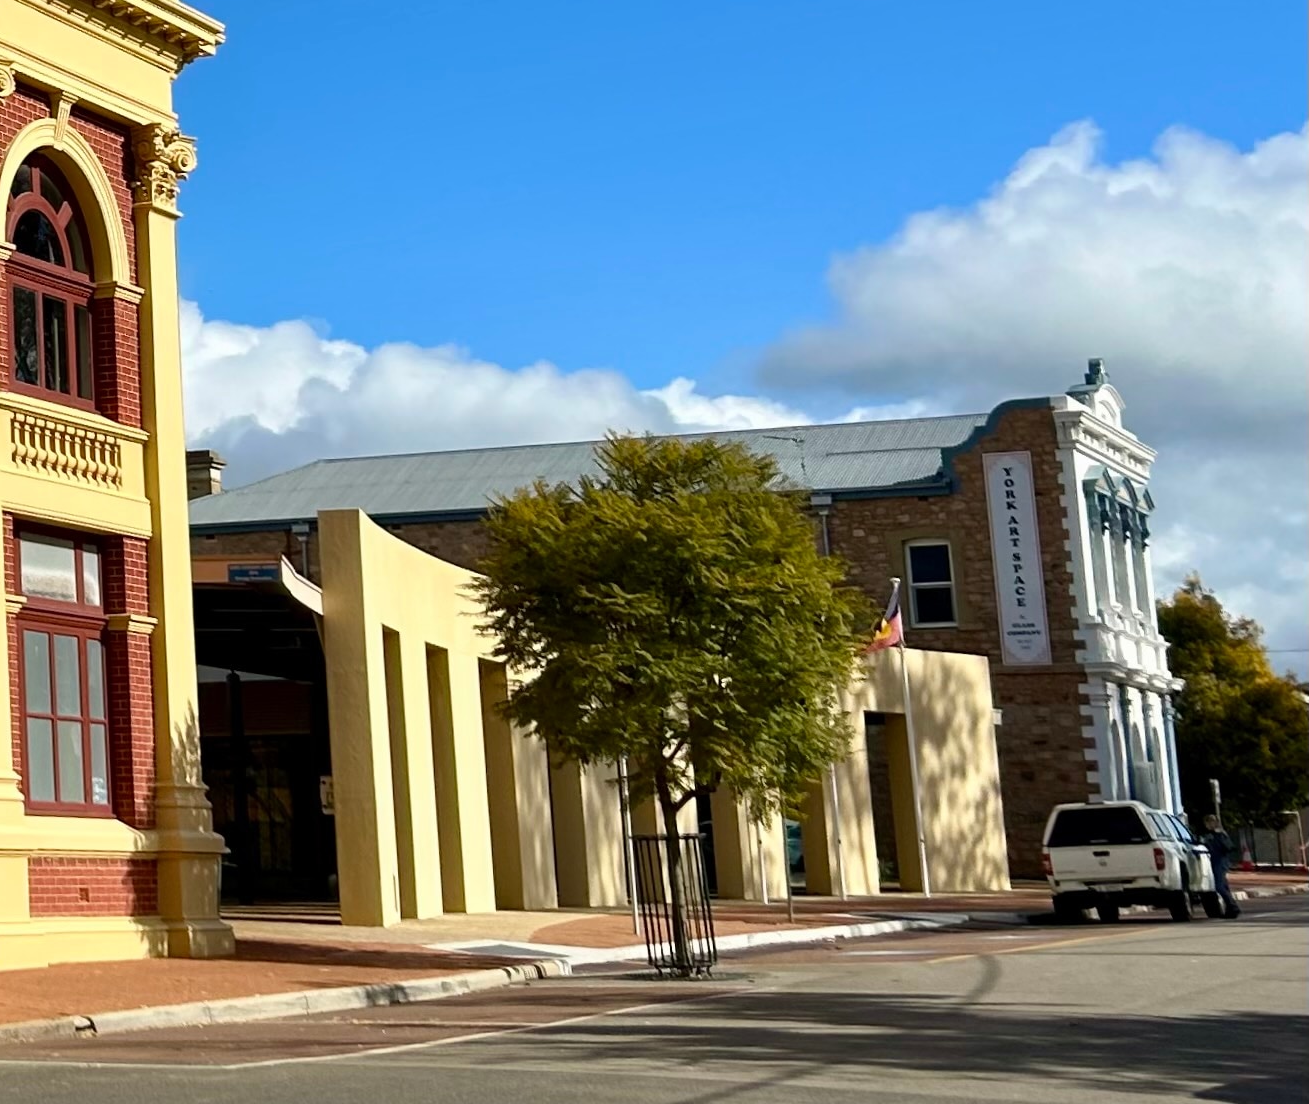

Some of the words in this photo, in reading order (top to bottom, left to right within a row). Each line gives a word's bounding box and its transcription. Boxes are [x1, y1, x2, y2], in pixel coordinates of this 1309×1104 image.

[1002, 466, 1018, 511] YORK
[1007, 515, 1021, 548] ART
[1012, 552, 1027, 608] SPACE
